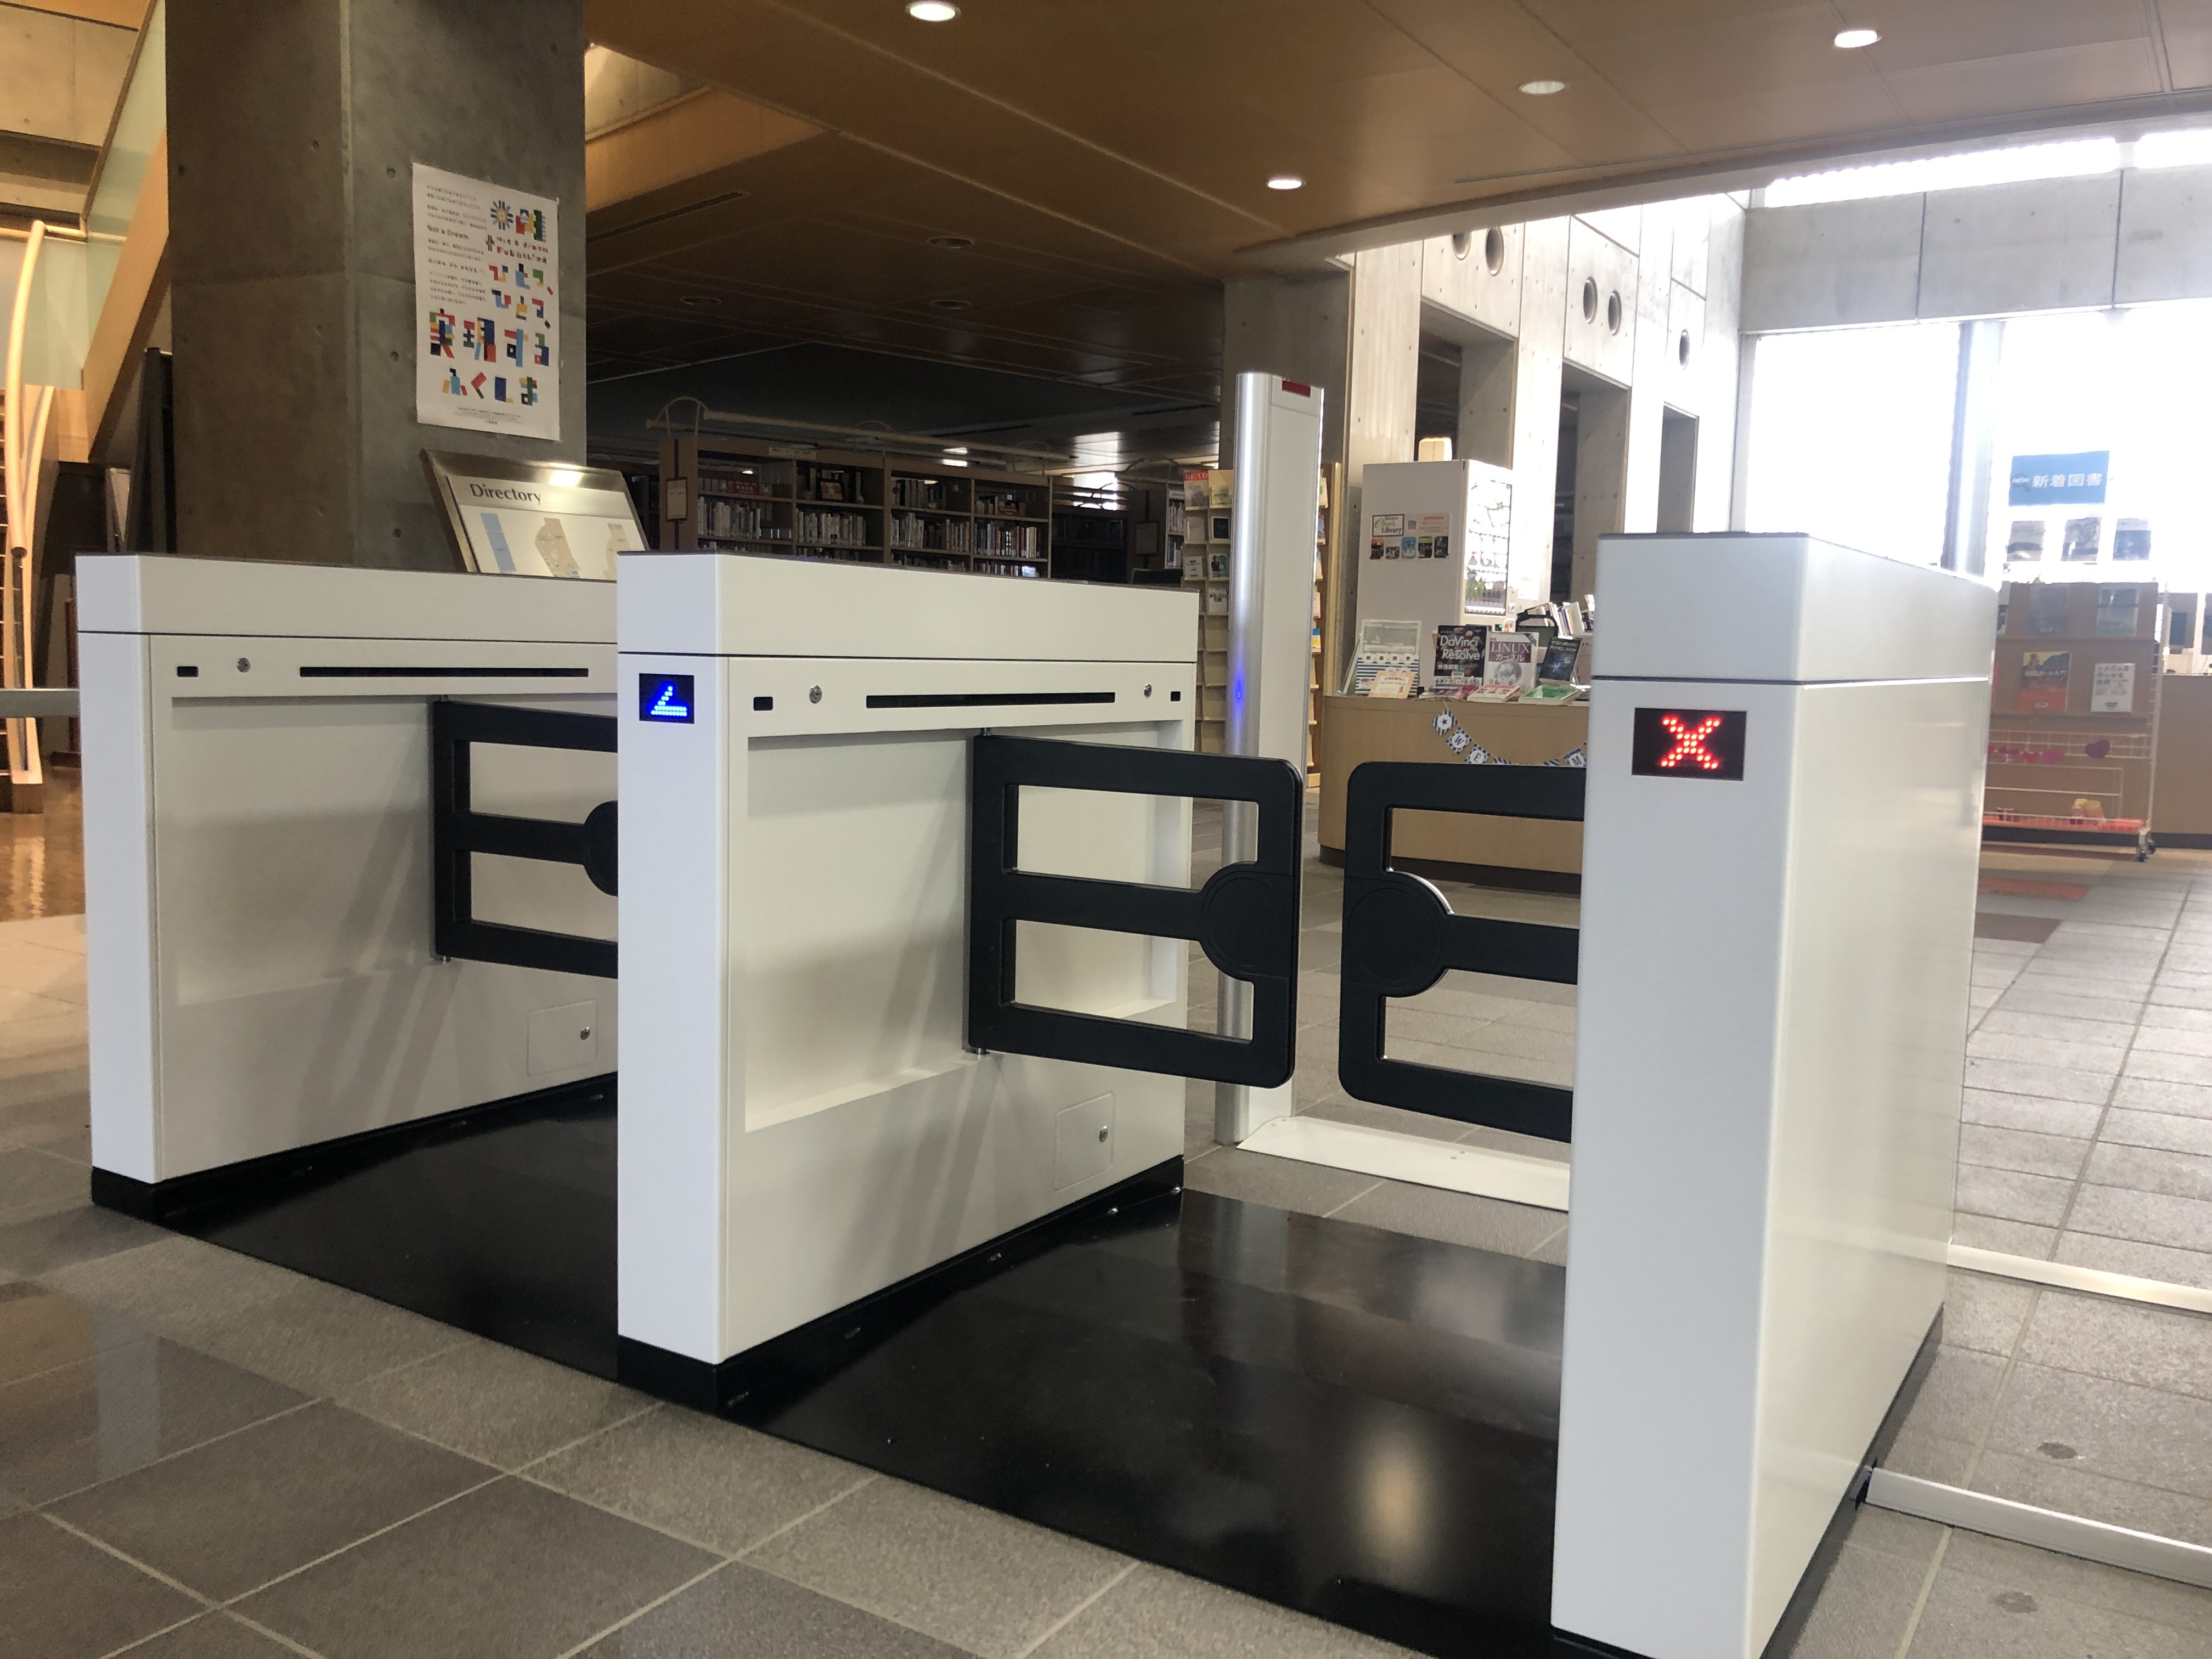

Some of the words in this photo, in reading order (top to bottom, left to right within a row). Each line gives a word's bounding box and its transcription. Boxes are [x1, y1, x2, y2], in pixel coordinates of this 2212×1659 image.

[430, 308, 550, 368] 実現する
[2032, 472, 2102, 488] 新着図書
[470, 483, 541, 506] Directory
[1381, 527, 1402, 535] Library
[1440, 635, 1479, 647] DaVinci
[1491, 642, 1531, 653] LINUX
[1442, 648, 1481, 661] Resolve
